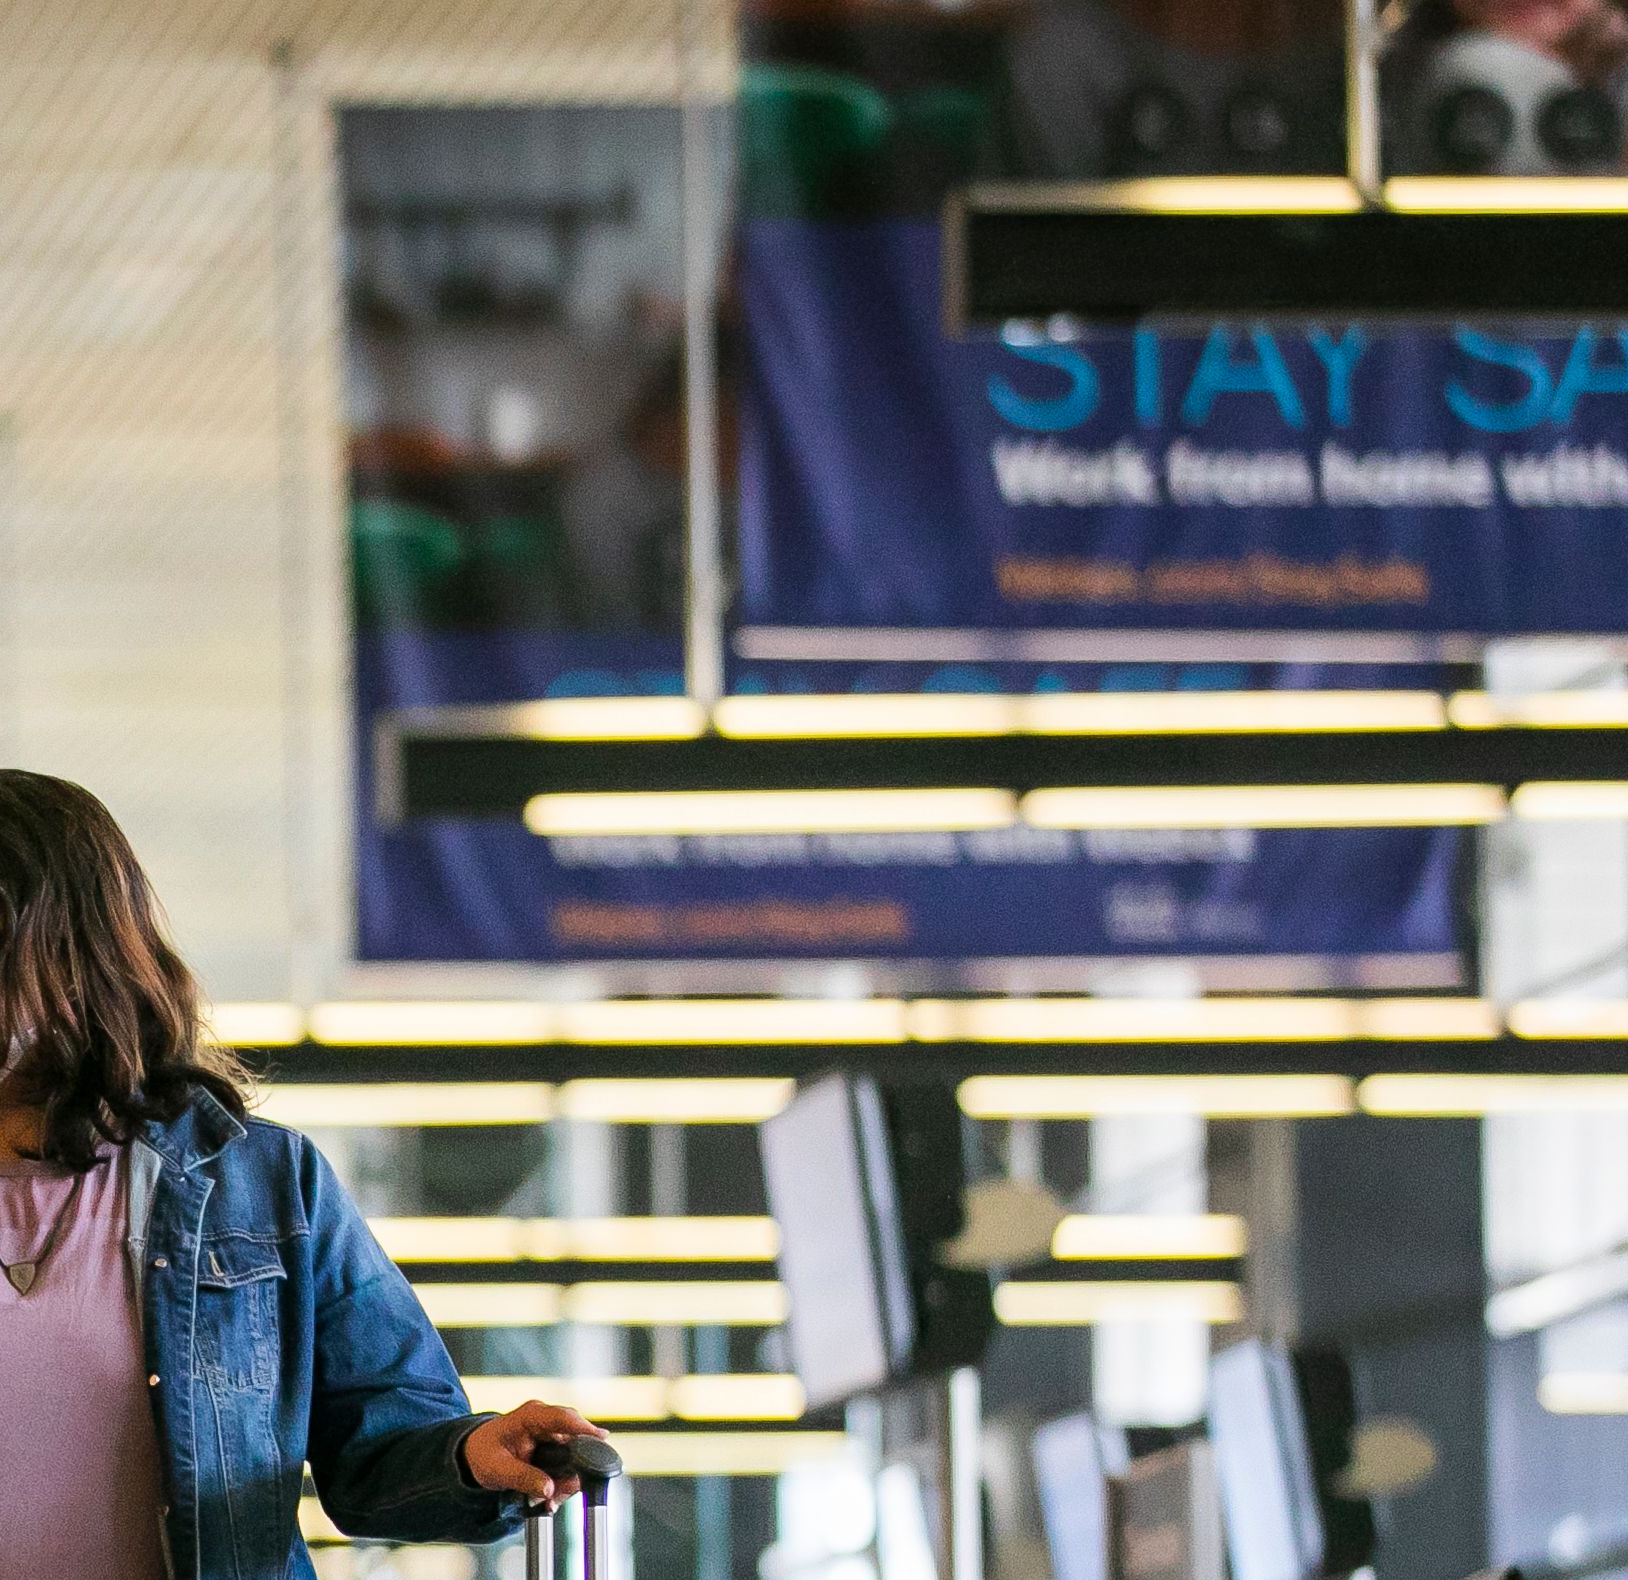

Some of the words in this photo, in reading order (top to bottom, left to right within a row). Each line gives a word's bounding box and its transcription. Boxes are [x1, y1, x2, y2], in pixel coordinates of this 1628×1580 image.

[994, 437, 1157, 506] Work
[1166, 437, 1314, 506] from
[1320, 437, 1493, 506] home
